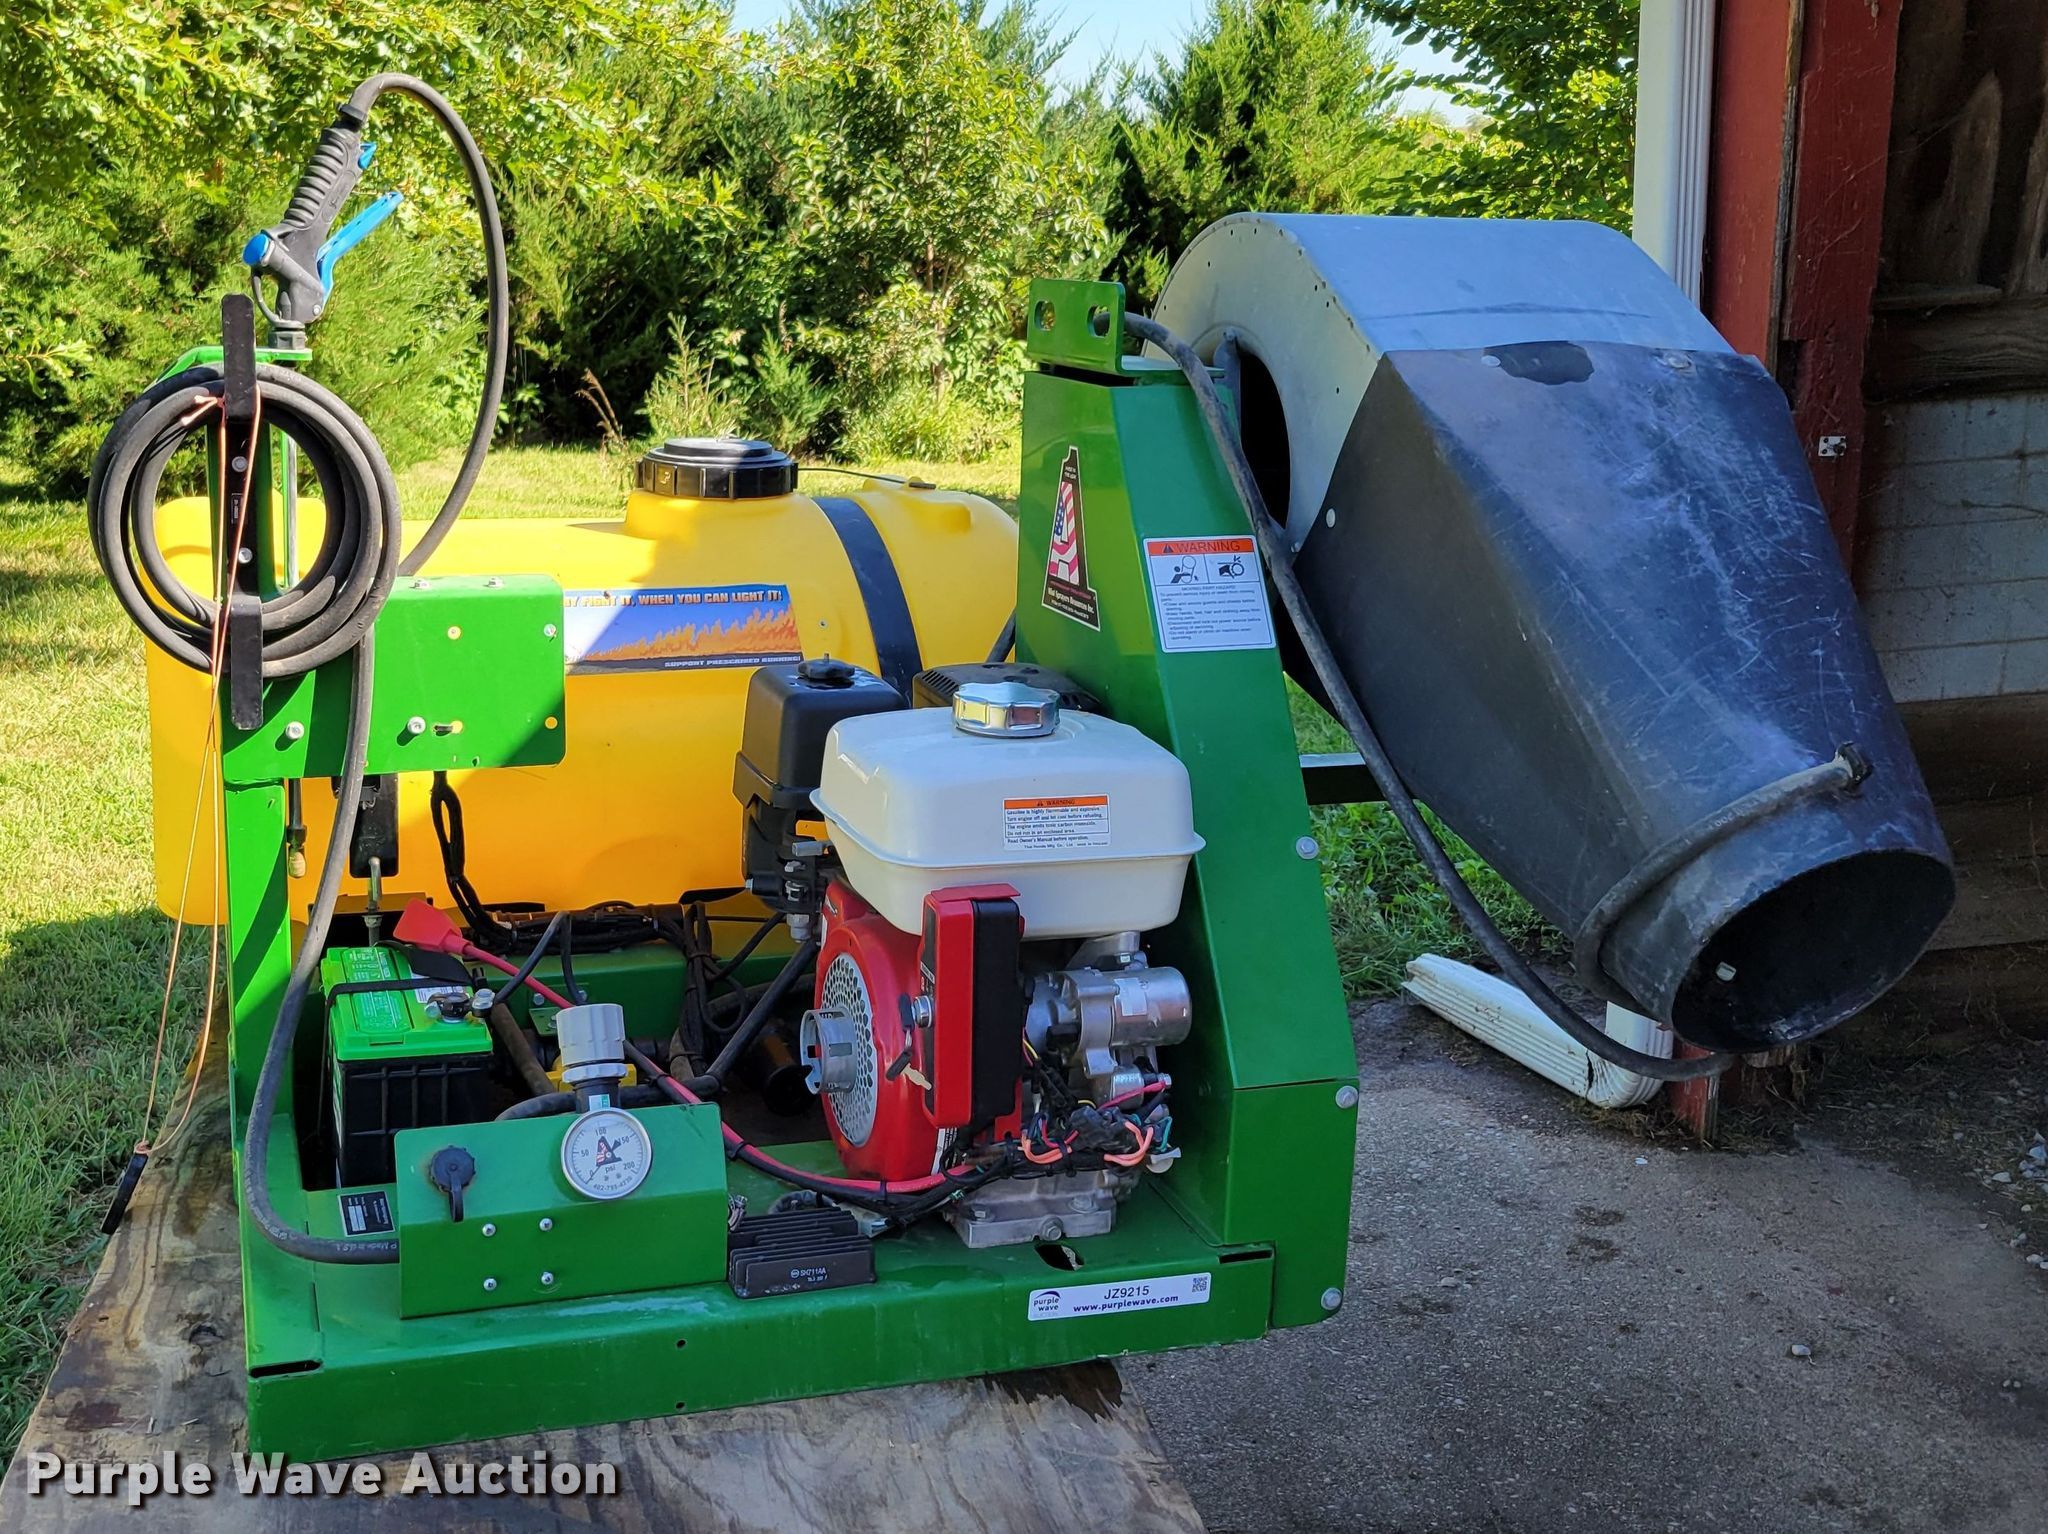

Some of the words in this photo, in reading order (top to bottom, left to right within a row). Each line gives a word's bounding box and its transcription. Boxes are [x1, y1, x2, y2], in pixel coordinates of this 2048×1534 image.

[1176, 541, 1240, 553] WARNING
[621, 594, 636, 607] IT,
[638, 594, 674, 605] WHEN
[677, 593, 701, 604] YOU
[704, 592, 729, 603] CAN
[731, 591, 764, 603] LIGHT
[767, 590, 783, 602] IT!
[596, 1128, 606, 1136] 100
[581, 1149, 589, 1157] 50
[605, 1165, 616, 1173] psi
[623, 1161, 635, 1170] 200
[1104, 1285, 1150, 1299] JZ9215
[1033, 1297, 1059, 1306] purple
[1073, 1295, 1179, 1312] www.purplewave.com
